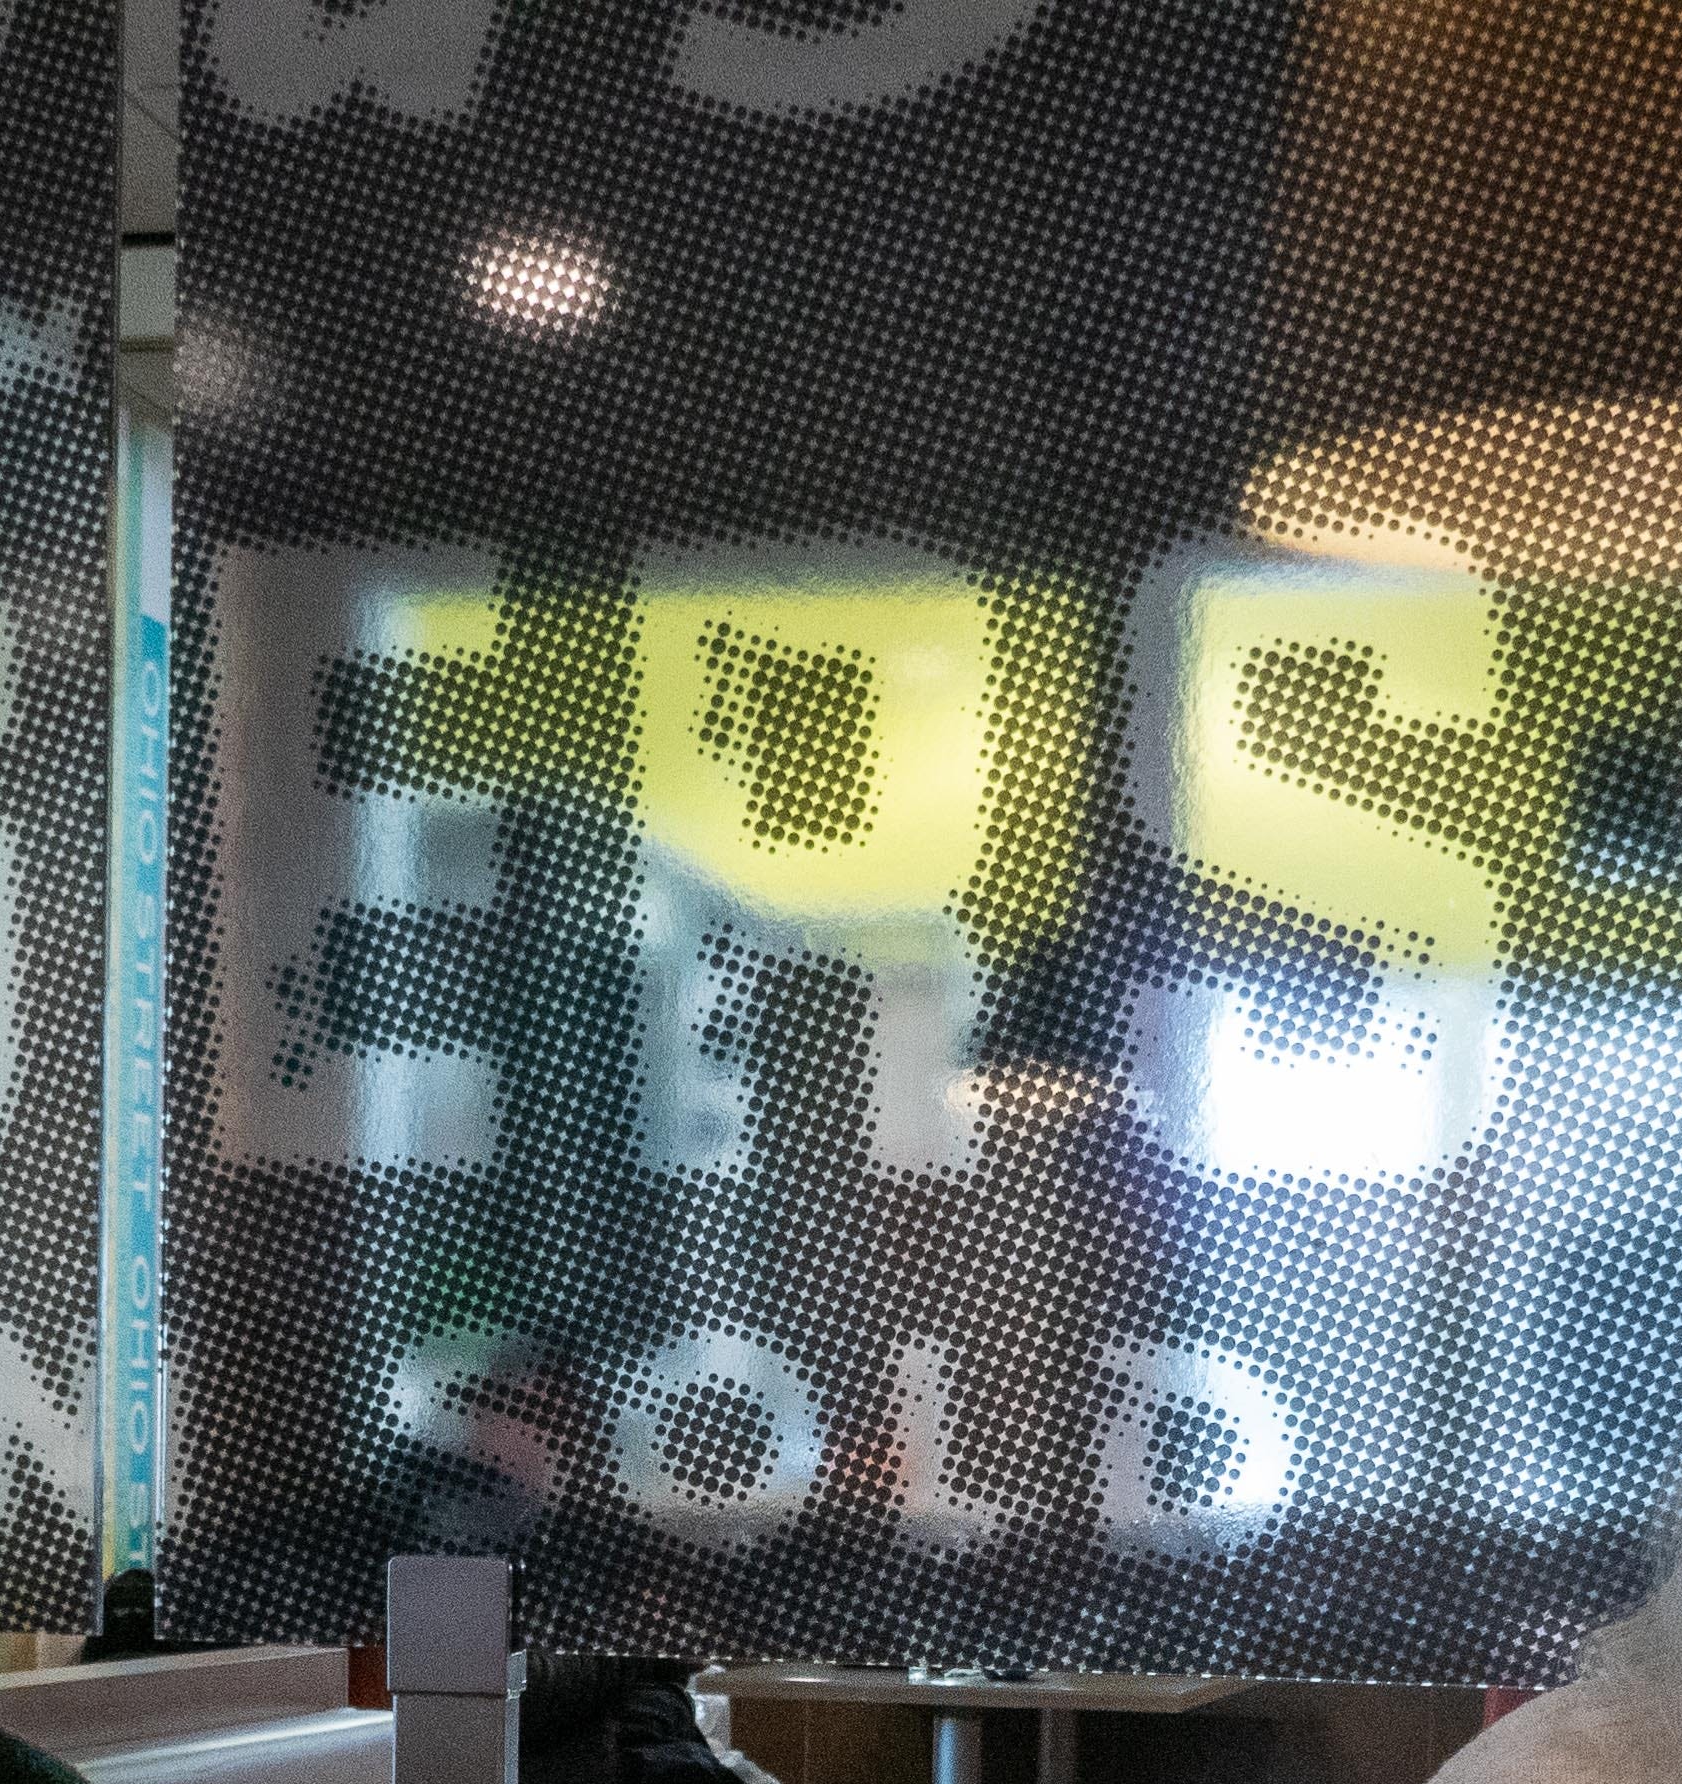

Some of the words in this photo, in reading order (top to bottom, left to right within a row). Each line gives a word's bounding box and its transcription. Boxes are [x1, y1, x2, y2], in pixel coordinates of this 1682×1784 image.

[139, 660, 160, 866] OHIO
[131, 892, 156, 1206] STREET
[130, 1254, 152, 1455] OHIO
[394, 1326, 1303, 1548] SOLD
